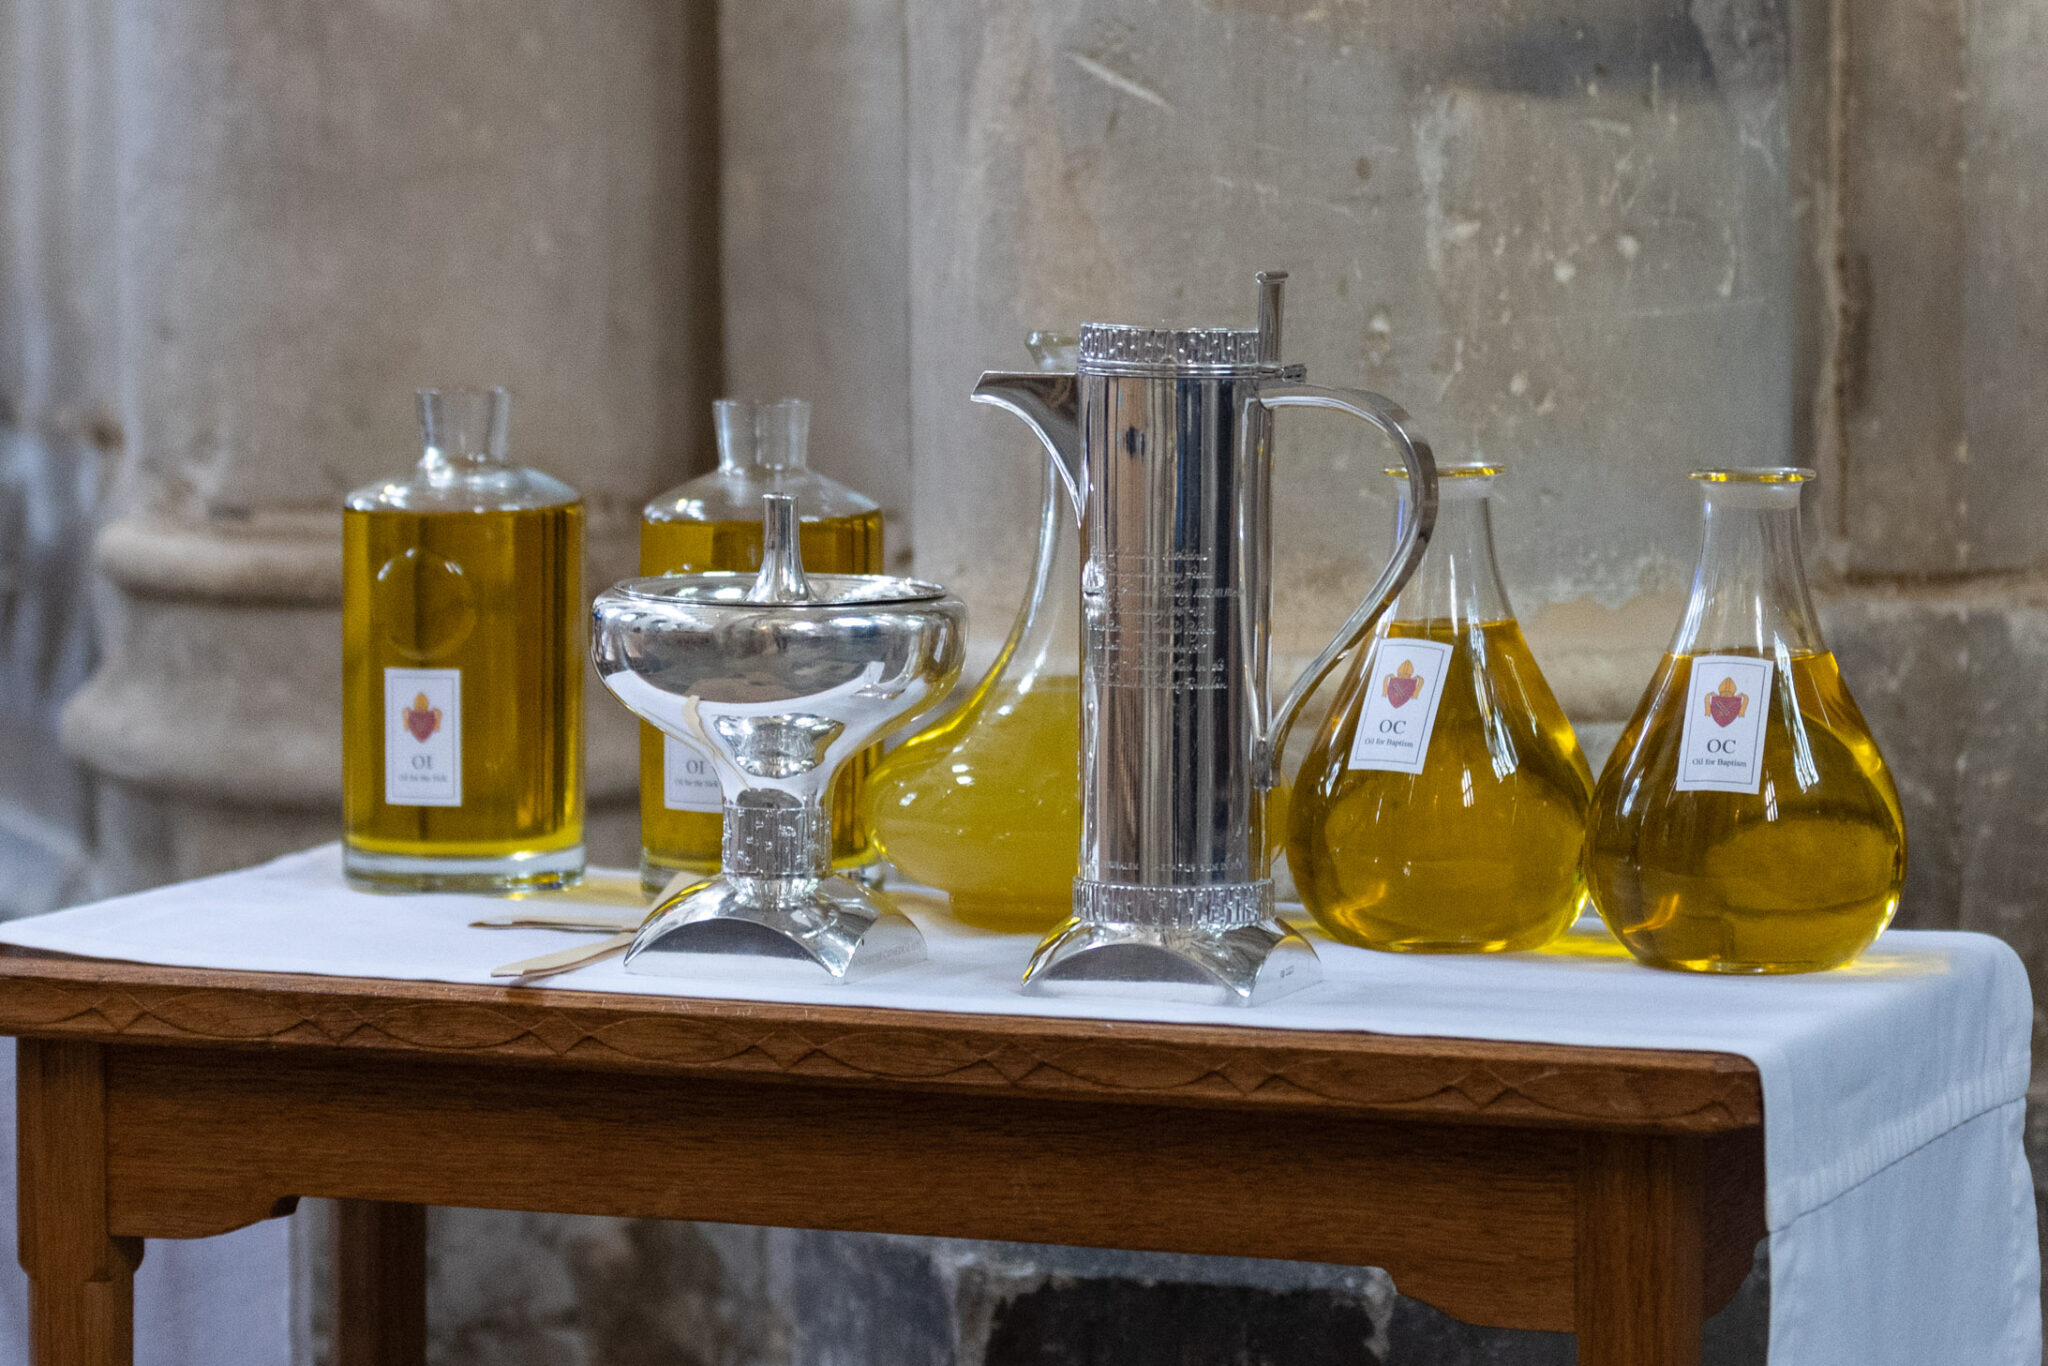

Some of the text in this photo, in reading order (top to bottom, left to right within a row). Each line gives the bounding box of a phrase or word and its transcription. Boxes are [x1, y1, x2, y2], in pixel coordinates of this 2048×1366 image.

[1379, 719, 1407, 735] OC
[1364, 737, 1375, 745] Oil
[1386, 738, 1414, 748] Baptism
[1707, 738, 1737, 754] OC
[411, 754, 433, 770] OI
[686, 759, 705, 775] OI
[1692, 758, 1747, 768] Oil for Baptism
